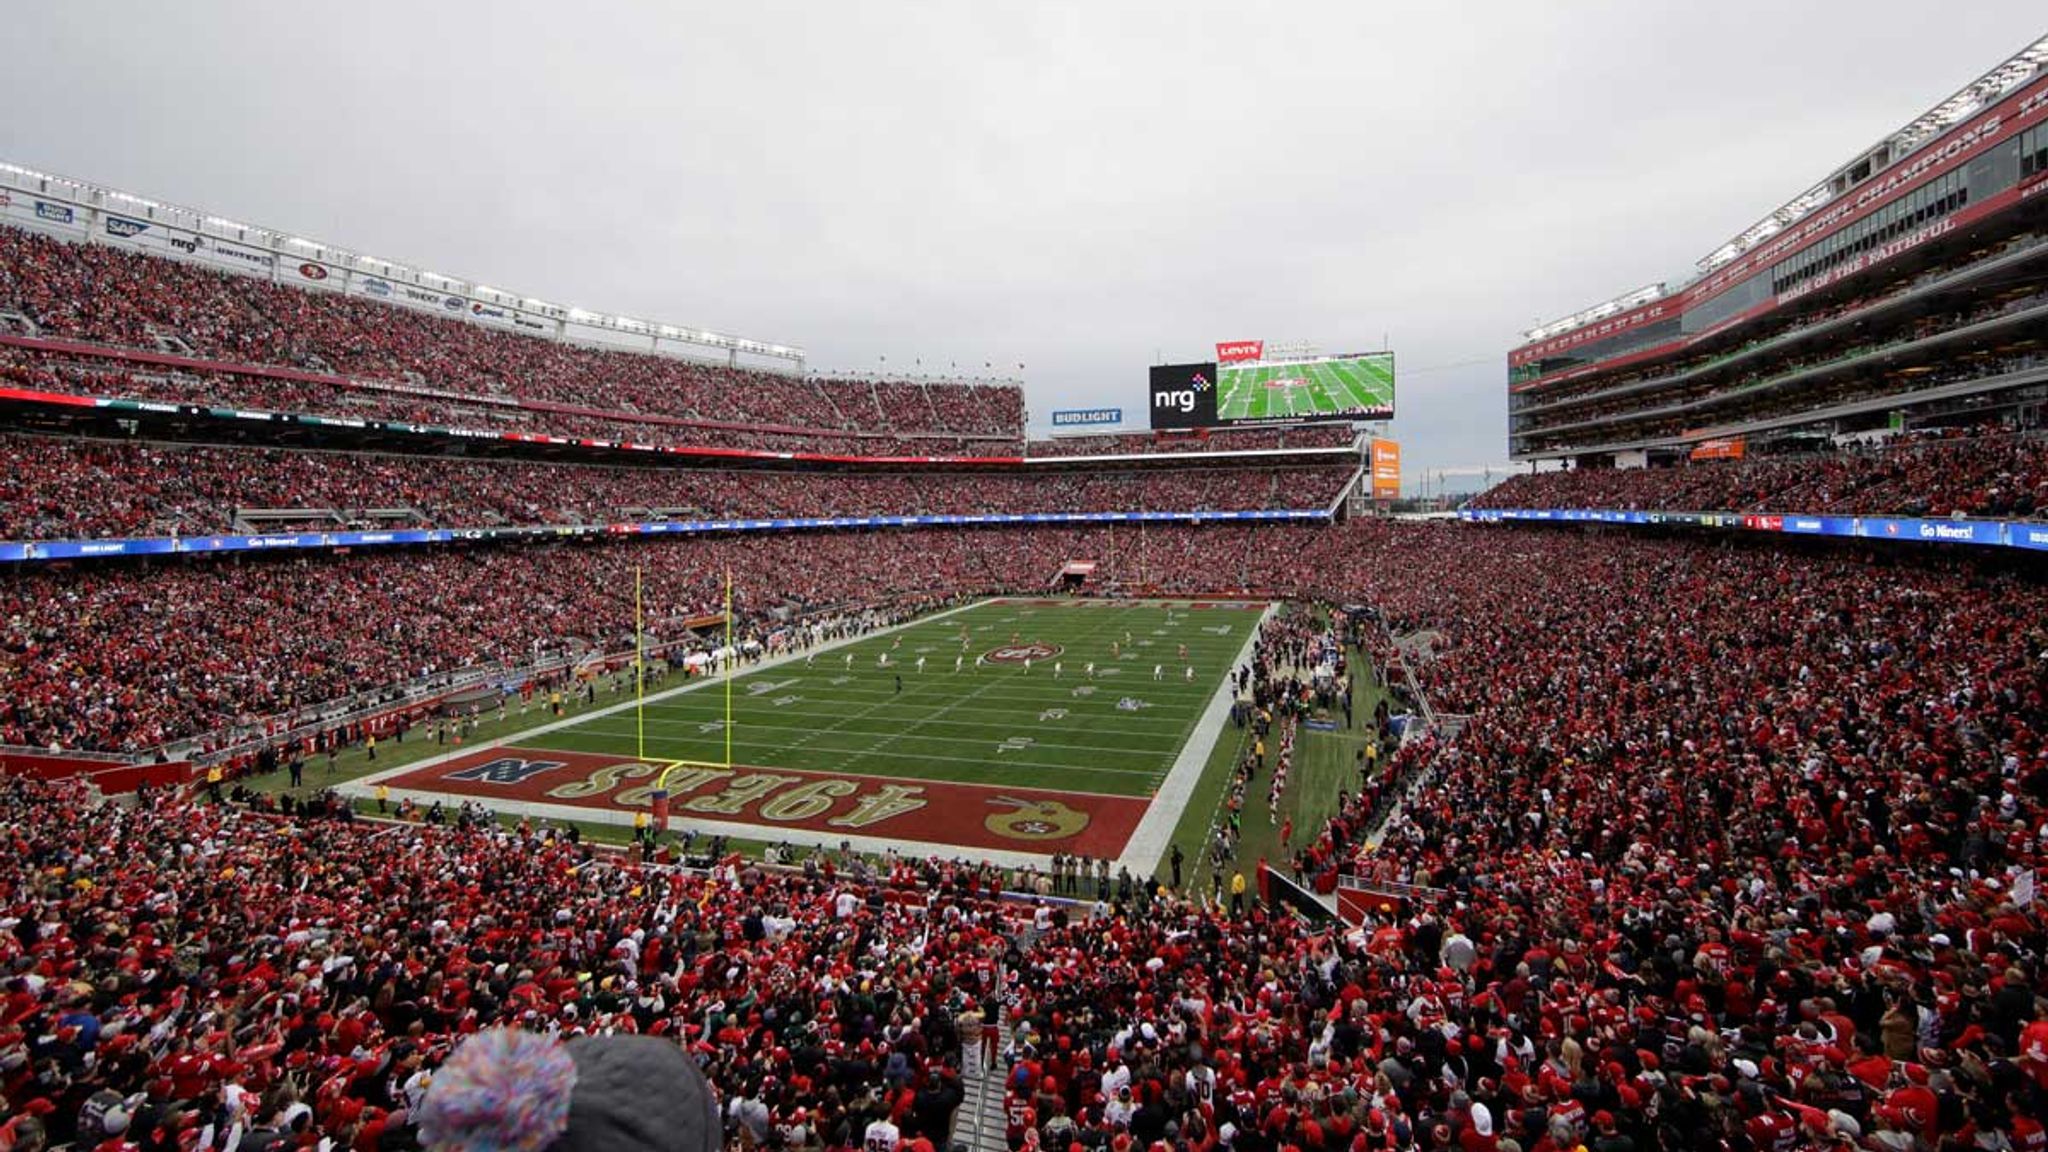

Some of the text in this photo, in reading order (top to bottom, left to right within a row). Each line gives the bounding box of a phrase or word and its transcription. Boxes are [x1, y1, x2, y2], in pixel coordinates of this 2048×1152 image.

[1805, 202, 1854, 238] BOWL
[1856, 115, 2001, 208] CHAMPIONS
[108, 218, 139, 233] SAP
[171, 237, 196, 253] nrg
[217, 247, 261, 263] UNITED
[1813, 272, 1832, 289] OF
[1835, 260, 1863, 282] THE
[1867, 219, 1956, 267] FAITHFUL
[1155, 389, 1195, 412] nrg
[1056, 410, 1119, 423] BUD LIGHT
[1920, 523, 1974, 540] Go Niners!
[248, 538, 263, 547] Go
